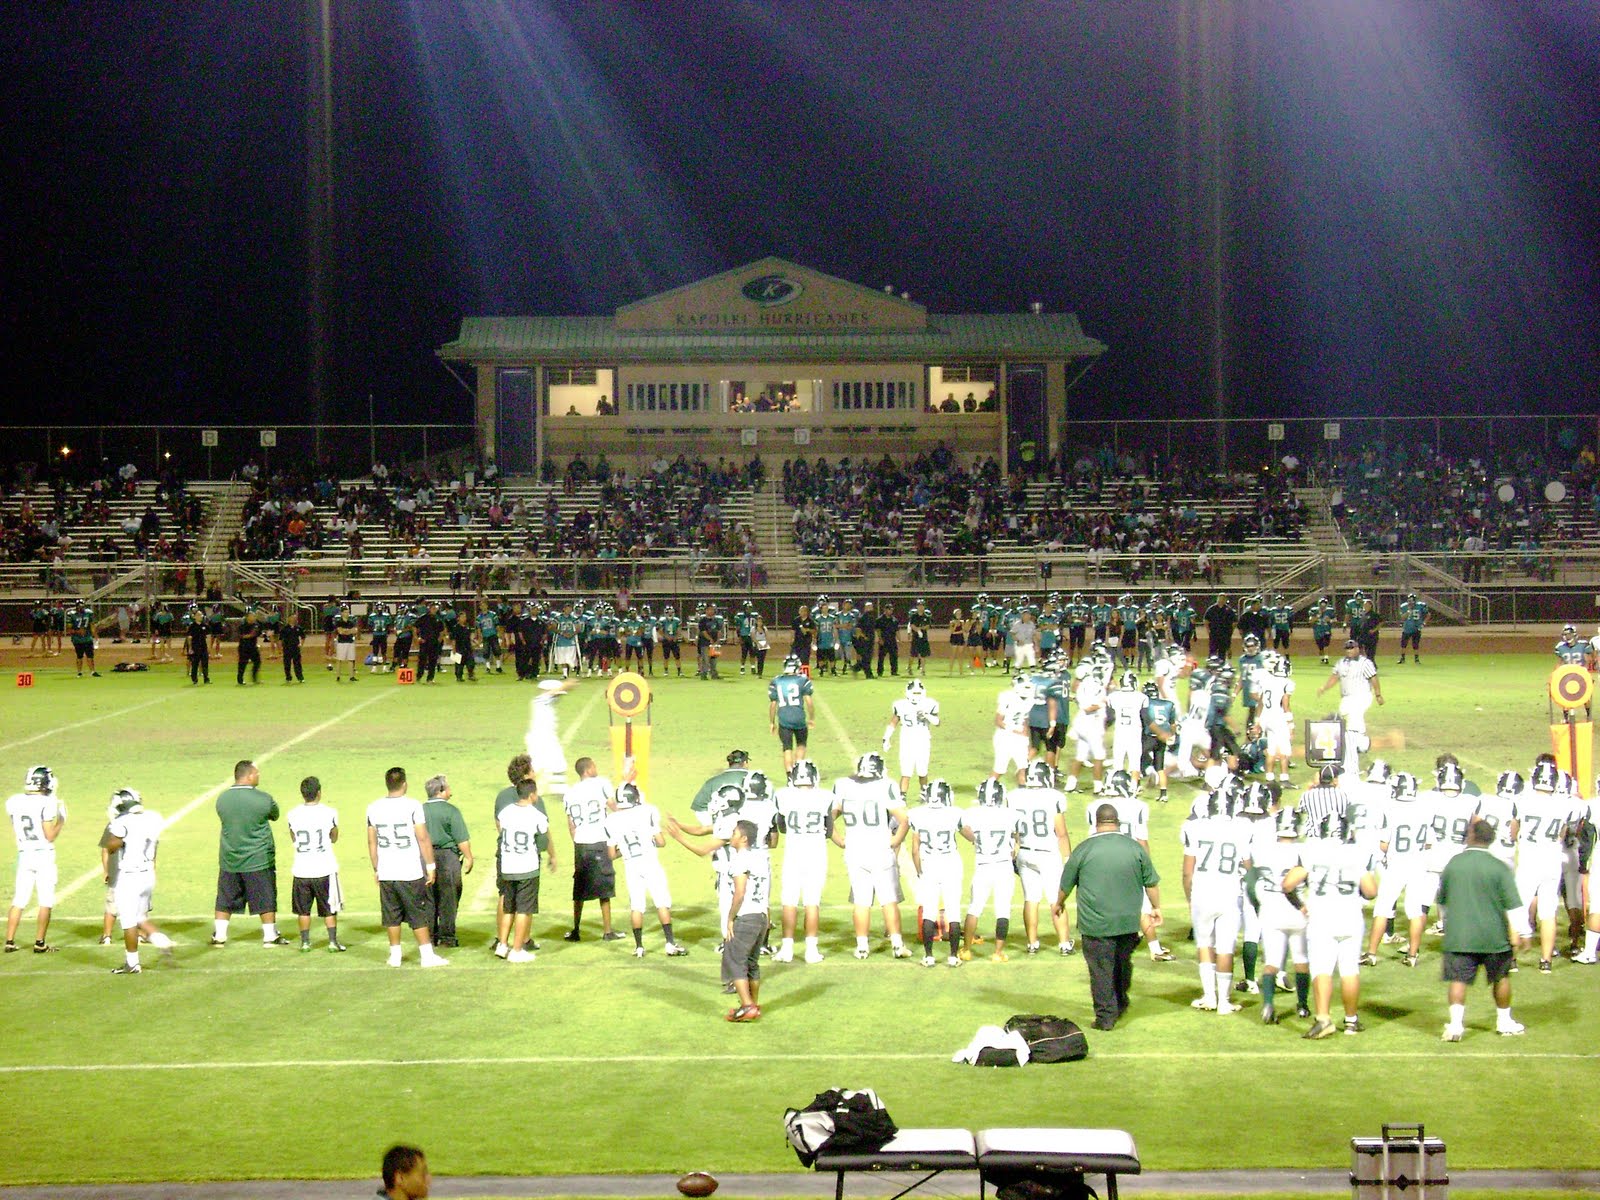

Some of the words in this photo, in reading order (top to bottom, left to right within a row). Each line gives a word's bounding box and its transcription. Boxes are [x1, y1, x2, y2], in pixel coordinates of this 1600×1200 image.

[759, 312, 870, 326] HURRICANES
[17, 674, 32, 687] 30
[399, 670, 413, 683] 40
[776, 683, 801, 707] 12
[1153, 705, 1167, 725] 5
[787, 810, 823, 835] 42
[1524, 815, 1562, 843] 74
[296, 828, 326, 853] 21
[375, 823, 412, 850] 55
[1395, 824, 1428, 853] 64
[1197, 839, 1237, 875] 78
[1311, 864, 1357, 897] 75
